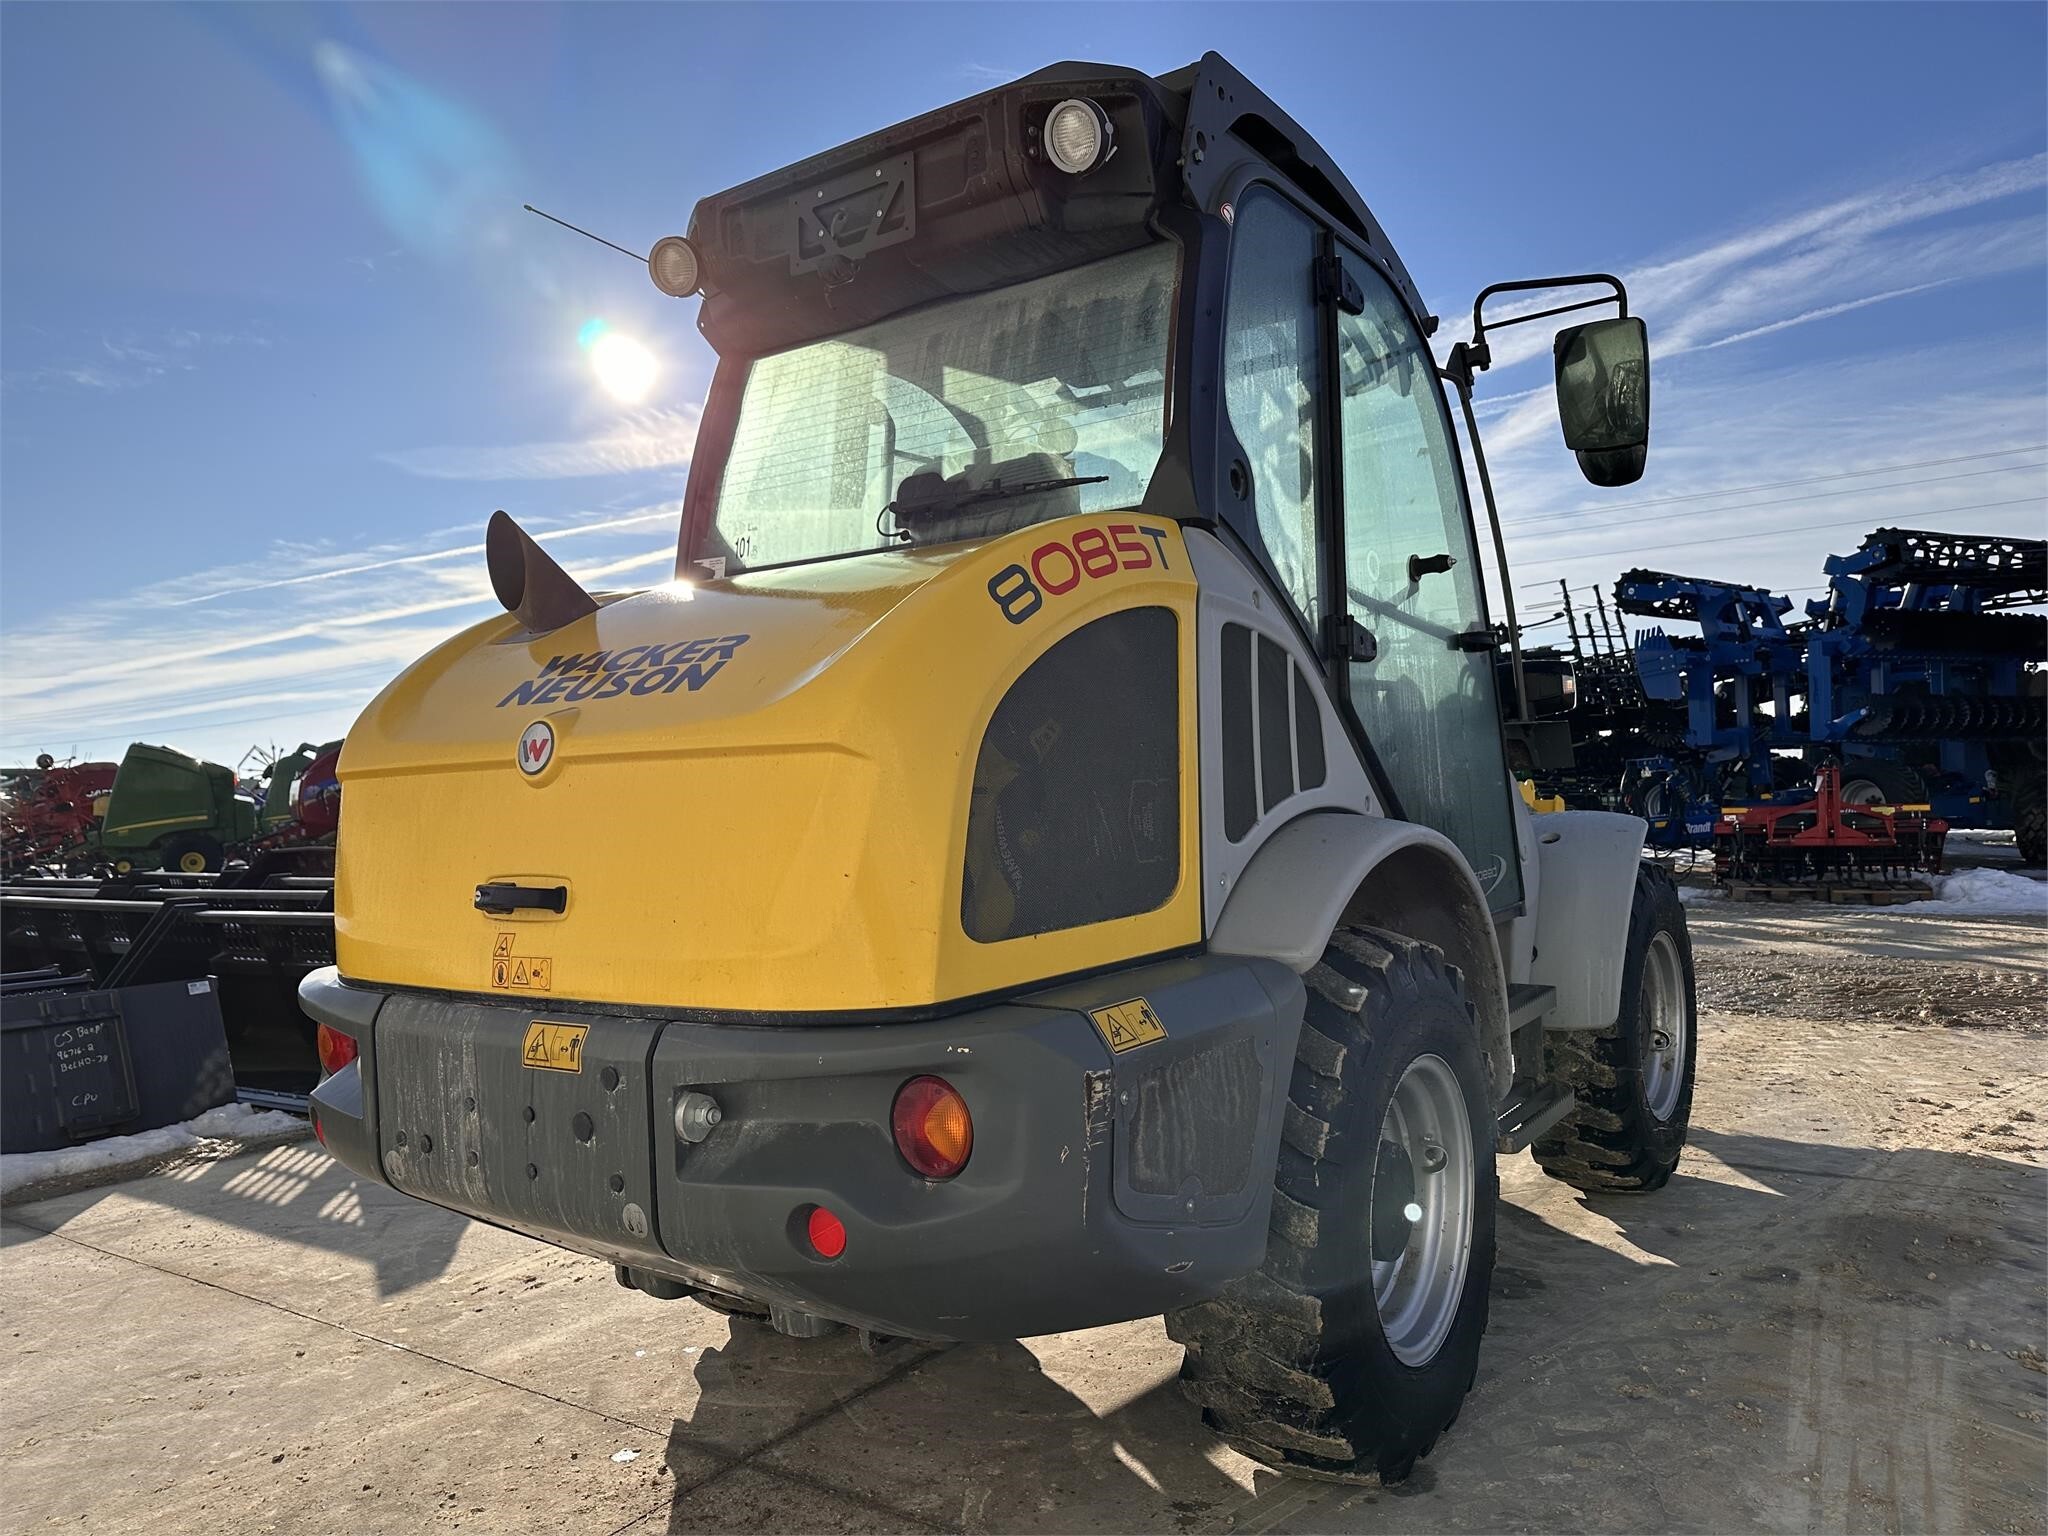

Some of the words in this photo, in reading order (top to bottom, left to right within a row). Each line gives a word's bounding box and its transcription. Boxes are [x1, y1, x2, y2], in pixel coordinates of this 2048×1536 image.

[735, 536, 751, 559] 101
[987, 525, 1169, 625] 8085T
[537, 634, 751, 679] WACKER
[496, 661, 729, 708] NEUSON
